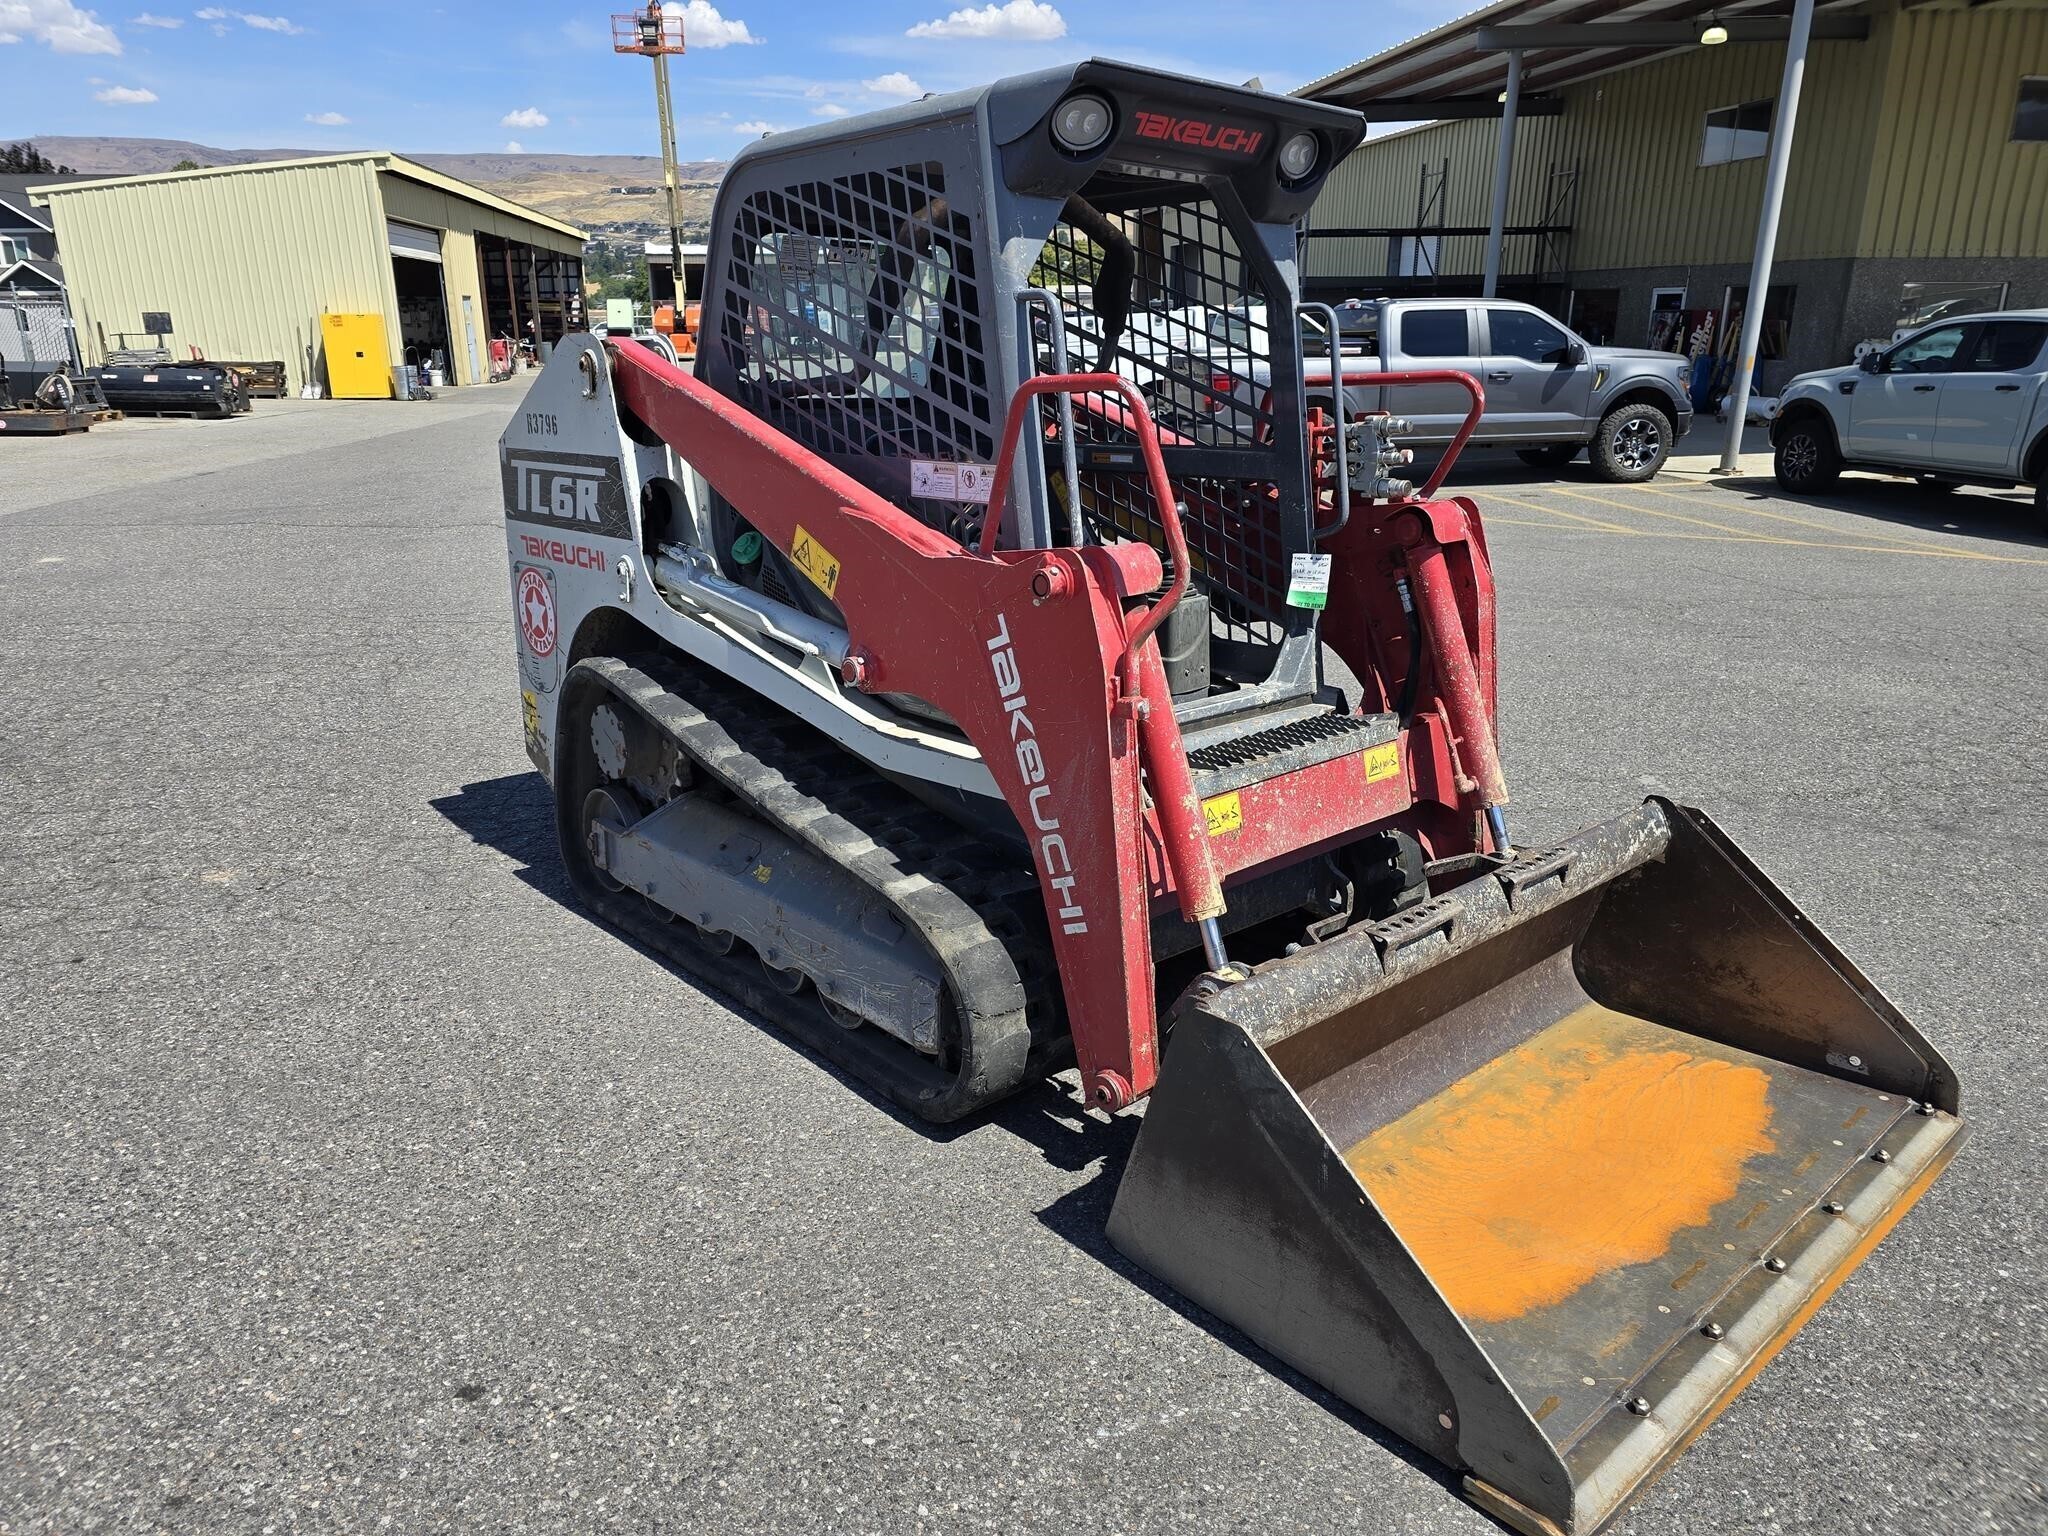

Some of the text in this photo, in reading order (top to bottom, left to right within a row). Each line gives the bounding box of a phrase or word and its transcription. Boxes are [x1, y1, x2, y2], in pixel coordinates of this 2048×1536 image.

[526, 413, 558, 436] R3796
[511, 459, 605, 523] TL6R
[523, 574, 553, 651] STAR RENTALS
